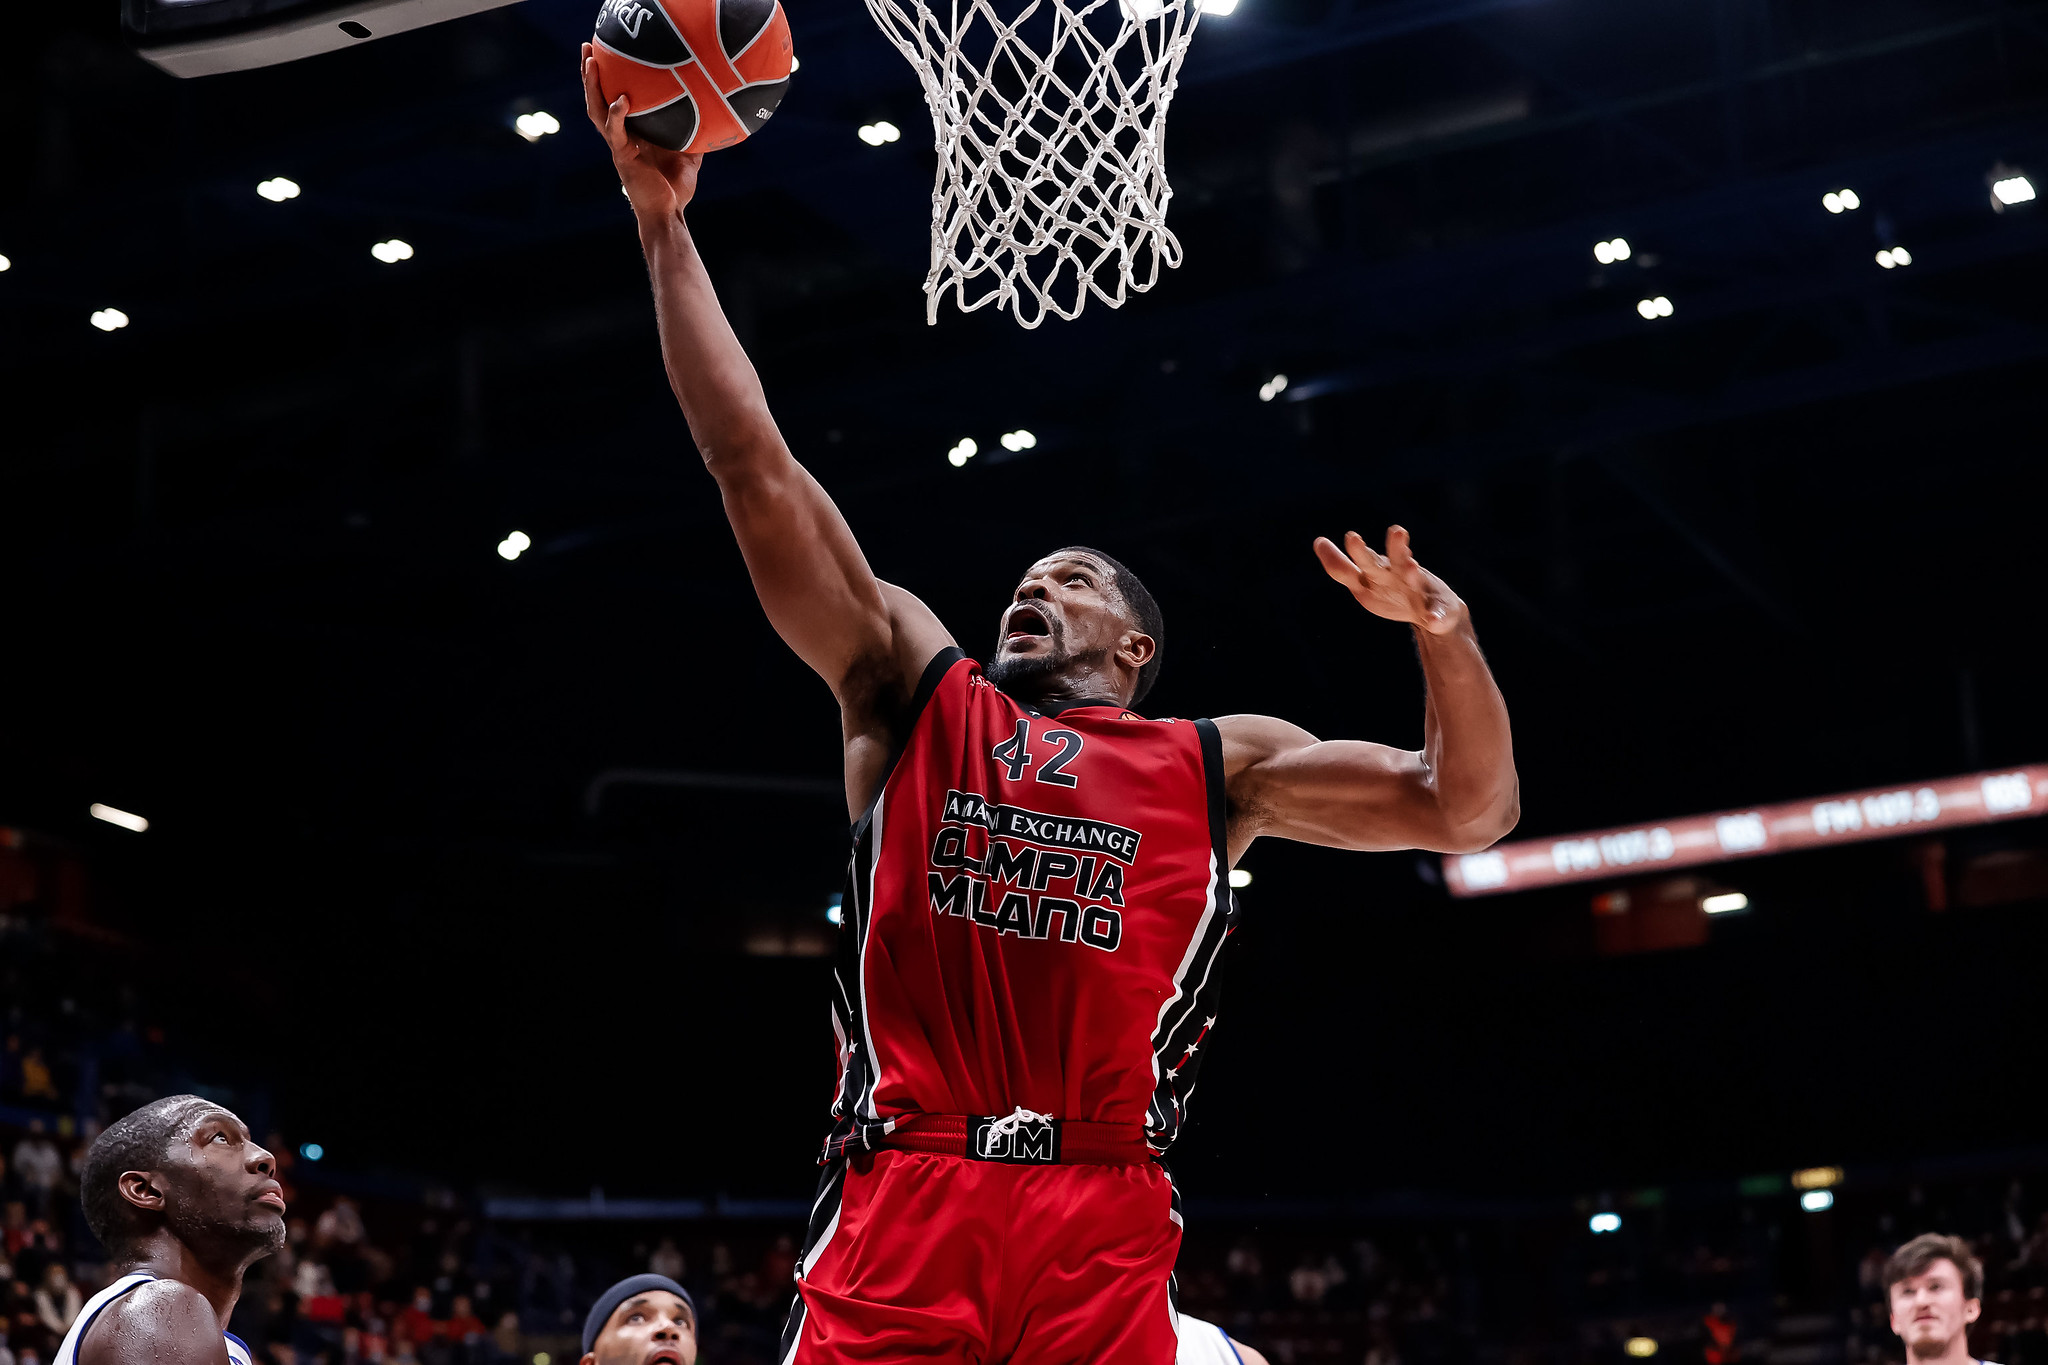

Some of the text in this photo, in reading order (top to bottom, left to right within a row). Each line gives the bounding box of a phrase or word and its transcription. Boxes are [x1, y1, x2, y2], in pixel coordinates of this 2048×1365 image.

[992, 718, 1084, 789] 42
[1010, 813, 1136, 856] EXCHANGE
[1812, 800, 1862, 834] FM
